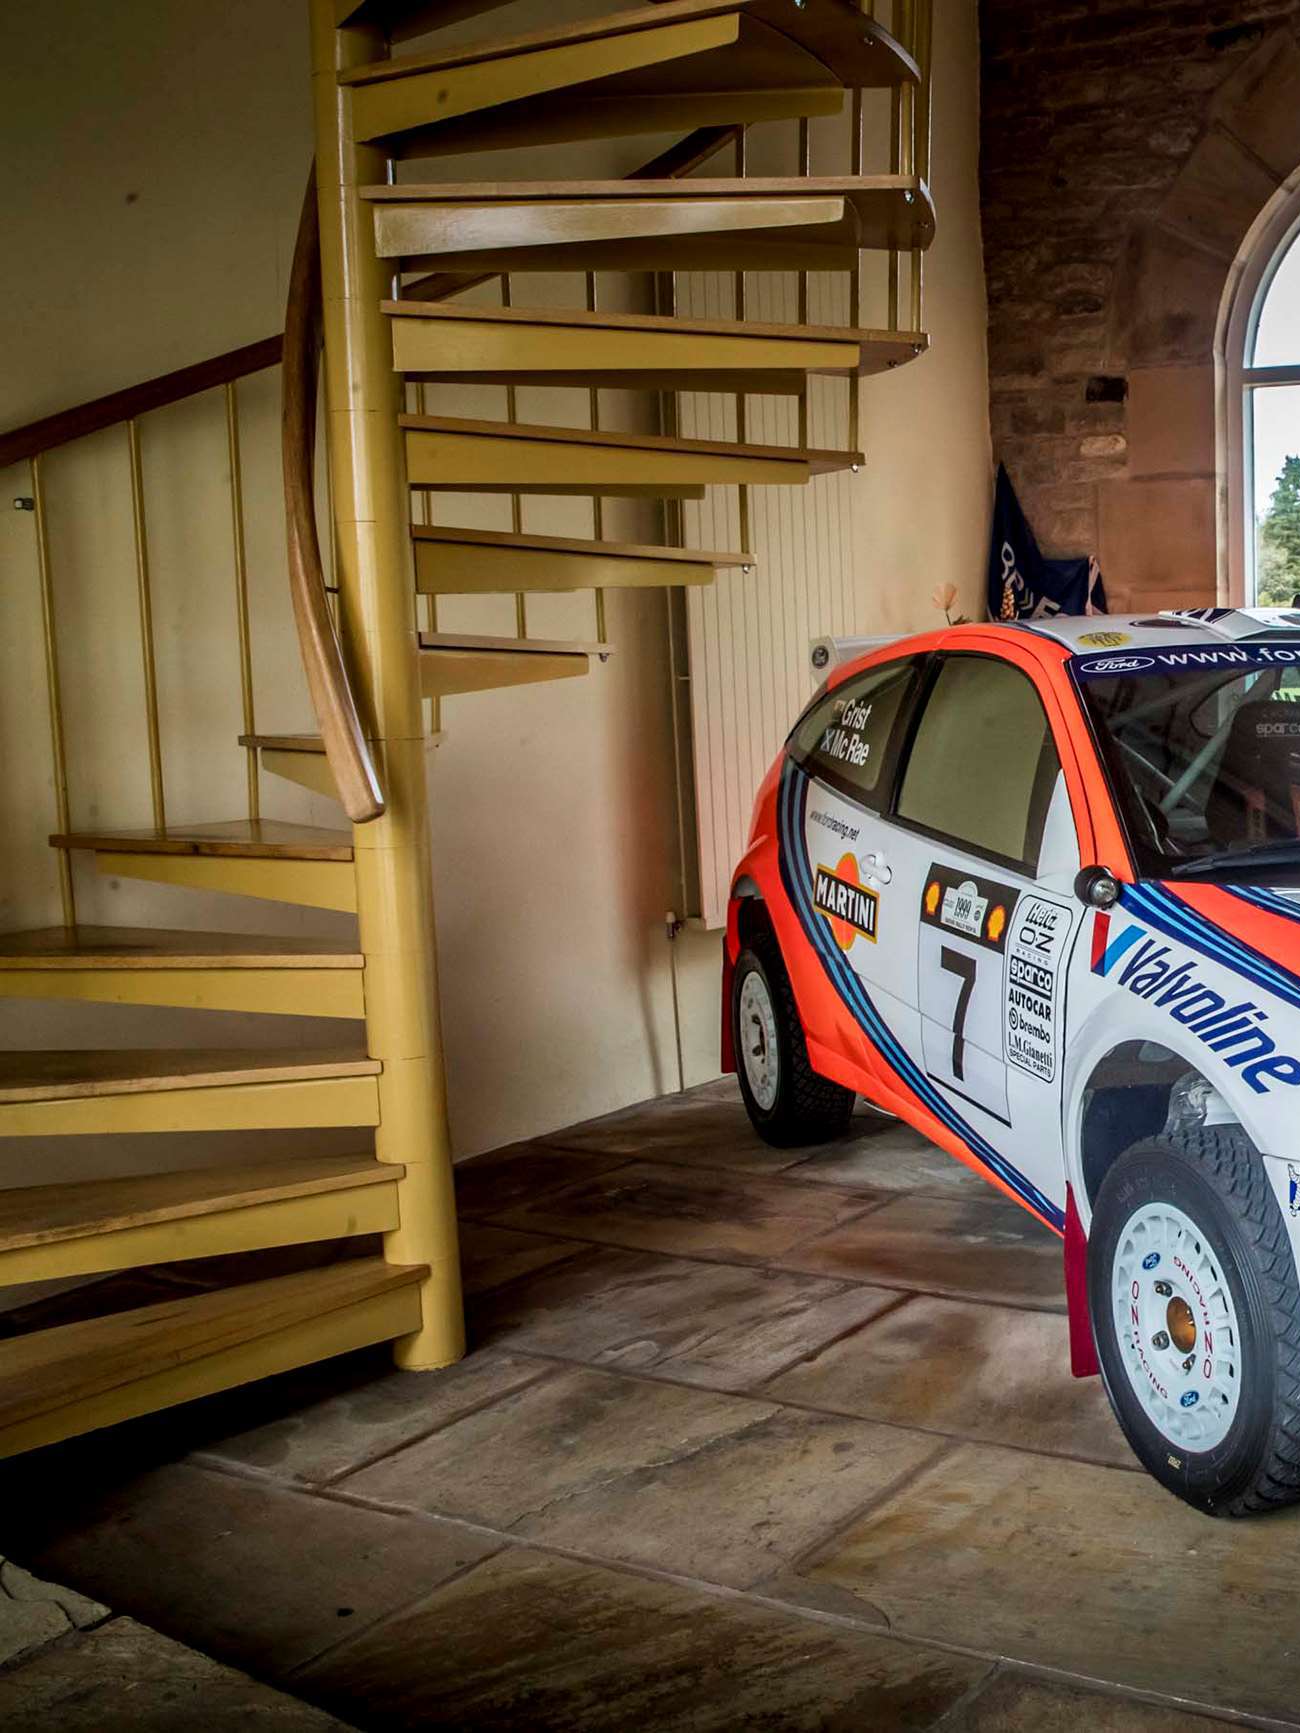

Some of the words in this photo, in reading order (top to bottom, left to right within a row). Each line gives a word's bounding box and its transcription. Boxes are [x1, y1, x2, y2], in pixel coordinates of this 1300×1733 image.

[1095, 658, 1140, 672] Ford
[841, 698, 873, 731] Grist
[816, 873, 875, 932] MARTINI
[1010, 957, 1052, 991] sparco
[940, 944, 977, 1082] 7
[1008, 987, 1052, 1022] AUTOCAR
[1019, 1012, 1051, 1044] brembo
